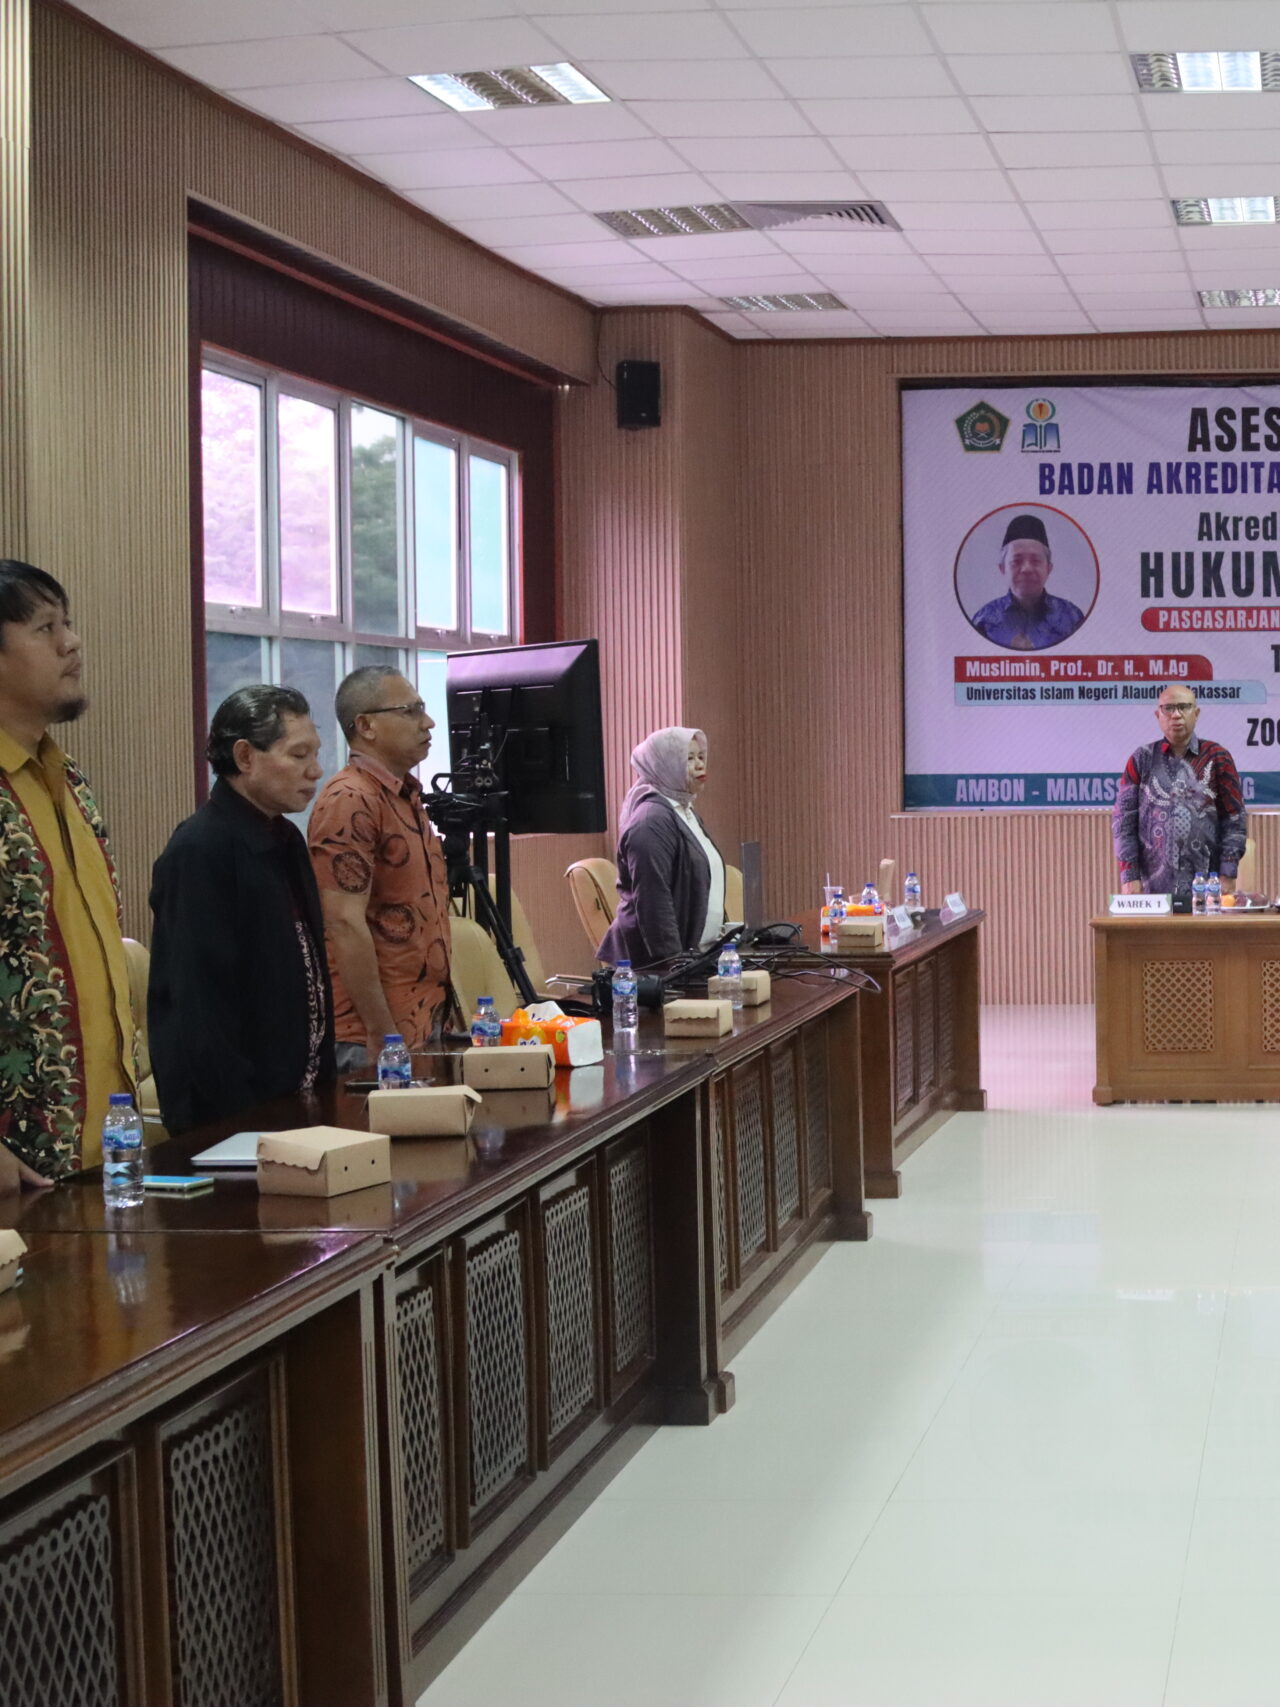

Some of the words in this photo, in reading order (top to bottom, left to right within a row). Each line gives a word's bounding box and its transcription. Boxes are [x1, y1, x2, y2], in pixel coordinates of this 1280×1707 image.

[1039, 462, 1133, 495] BADAN
[966, 660, 1045, 678] Muslimin,
[1051, 660, 1092, 678] Prof.,
[1097, 660, 1119, 677] Dr.
[1124, 660, 1144, 678] H.,
[1150, 659, 1188, 677] M.Ag
[966, 685, 1037, 701] Universitas
[1040, 685, 1074, 700] Islam
[1078, 684, 1118, 701] Negeri
[1122, 685, 1168, 699] Alaudd
[956, 778, 1025, 803] AMBON
